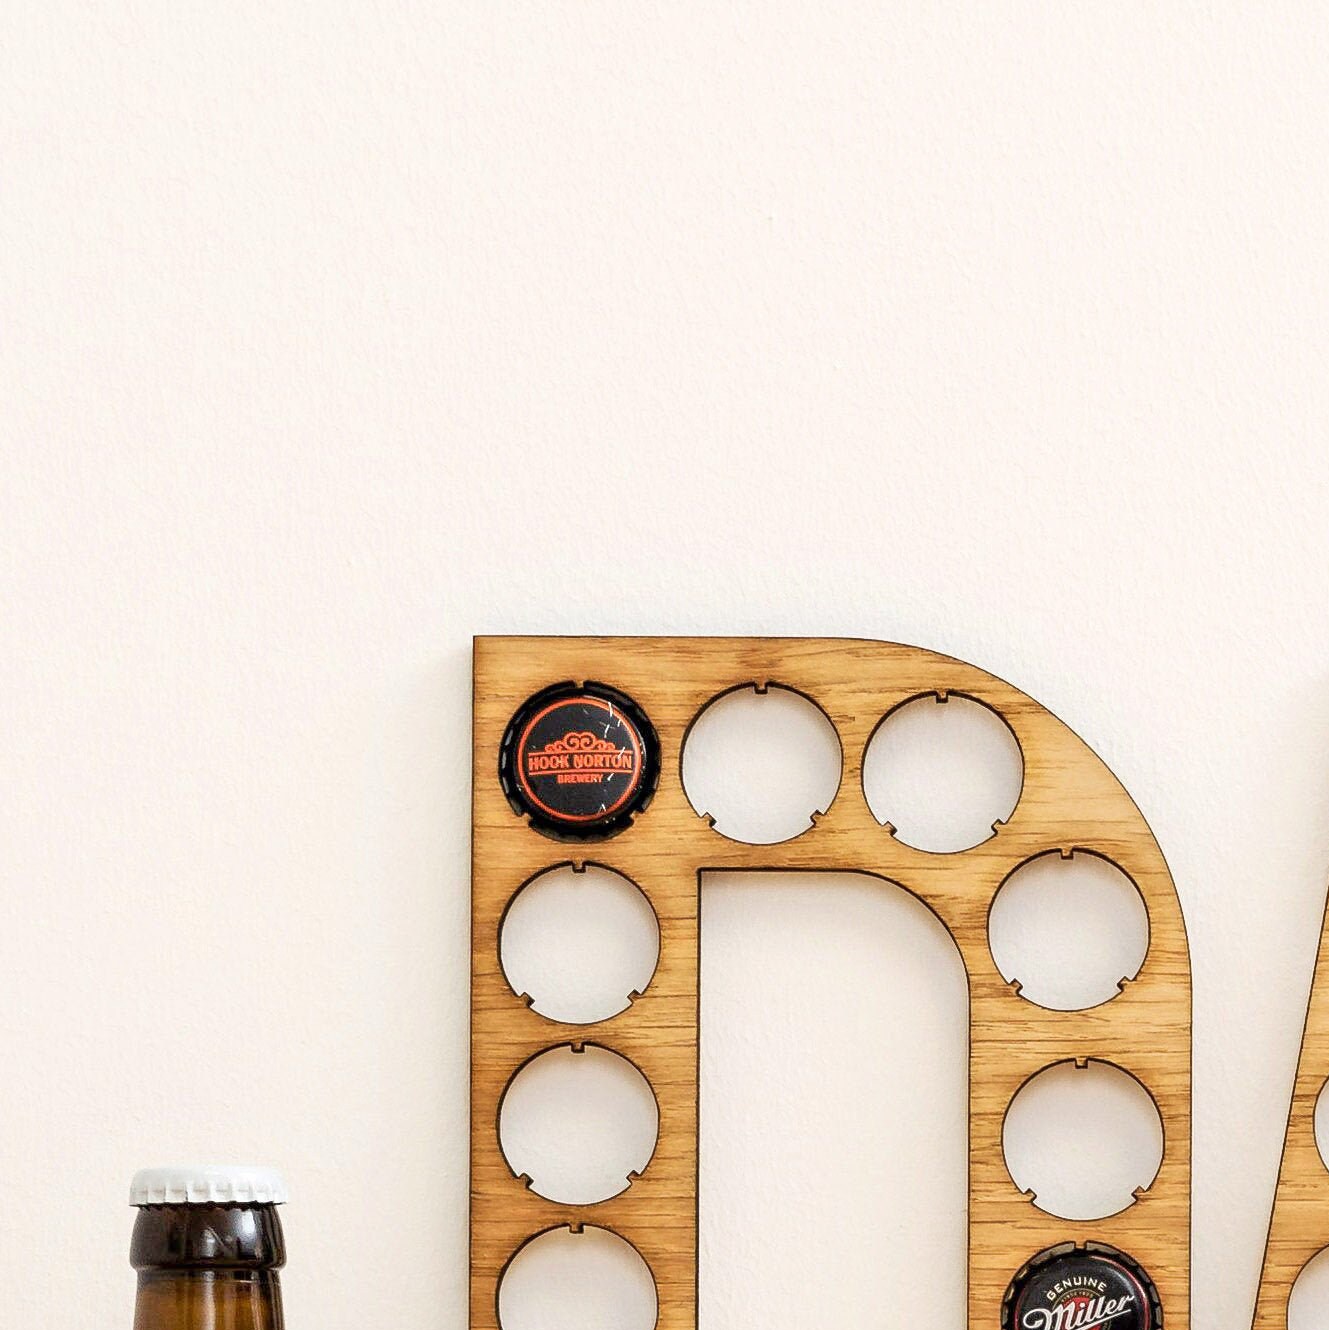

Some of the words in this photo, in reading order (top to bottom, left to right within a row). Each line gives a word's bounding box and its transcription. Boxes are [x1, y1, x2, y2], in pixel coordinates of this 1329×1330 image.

[528, 755, 568, 770] HOOK
[573, 754, 632, 769] NORTON
[557, 773, 603, 784] BREWERY
[1046, 1276, 1107, 1301] GENUINE
